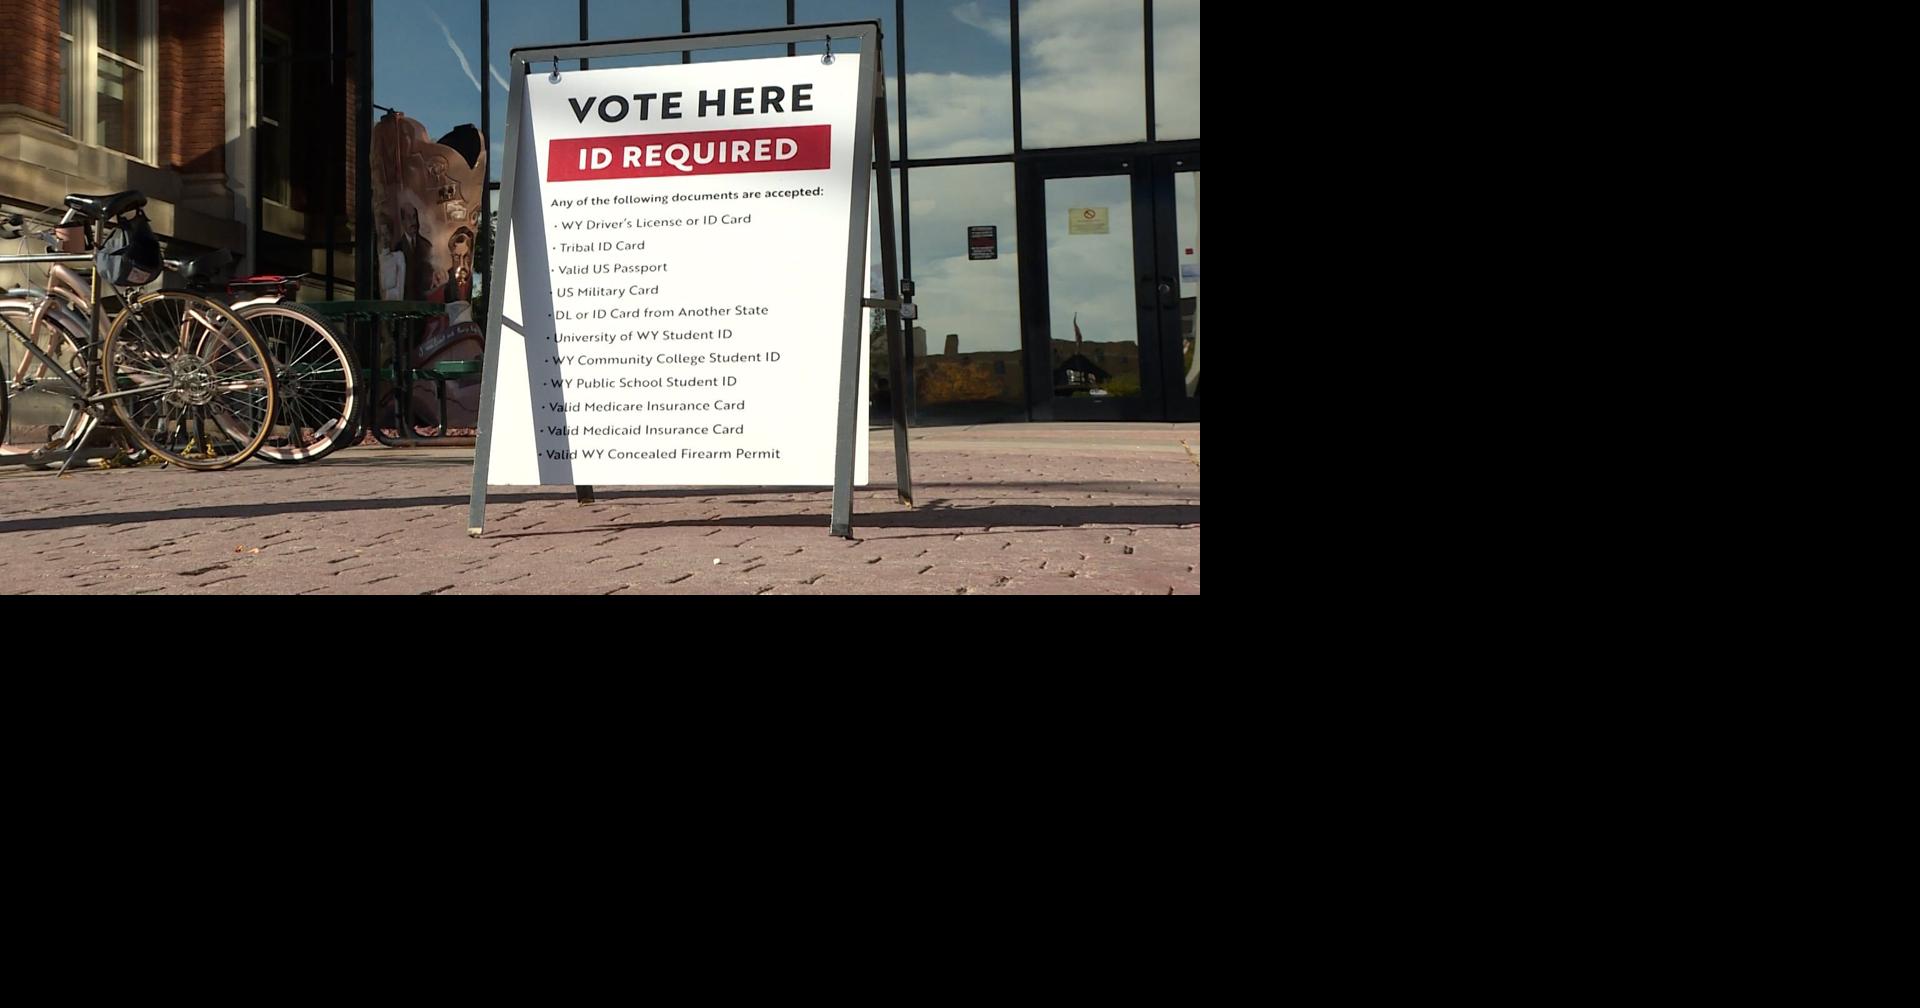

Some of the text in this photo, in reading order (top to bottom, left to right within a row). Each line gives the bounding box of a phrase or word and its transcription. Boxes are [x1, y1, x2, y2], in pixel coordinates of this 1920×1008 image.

[568, 83, 813, 124] VOTE HERE
[579, 138, 797, 172] ID REQUIRED
[551, 199, 573, 209] Any
[576, 197, 588, 206] of
[591, 197, 610, 205] the
[613, 194, 668, 204] following
[671, 191, 739, 202] documents
[765, 186, 824, 199] accepted:
[562, 221, 583, 230] WY
[587, 218, 632, 230] Driver's
[636, 219, 682, 228] License
[703, 215, 717, 225] ID
[721, 214, 751, 224] Card
[561, 240, 645, 252] Tribal ID Card
[558, 263, 667, 274] Valid US Passport
[557, 285, 658, 298] US Military Card
[556, 305, 768, 320] DL or ID Card from Another State
[554, 329, 732, 344] University of WY Student ID
[552, 351, 780, 367] WY Community College Student ID
[550, 376, 737, 389] WY Public School Student ID
[549, 400, 745, 413] Valid Medicare Insurance Card
[547, 424, 743, 436] Valid Medicaid Insurance Card
[546, 448, 780, 460] Valid WY Concealed Firearm Permit
